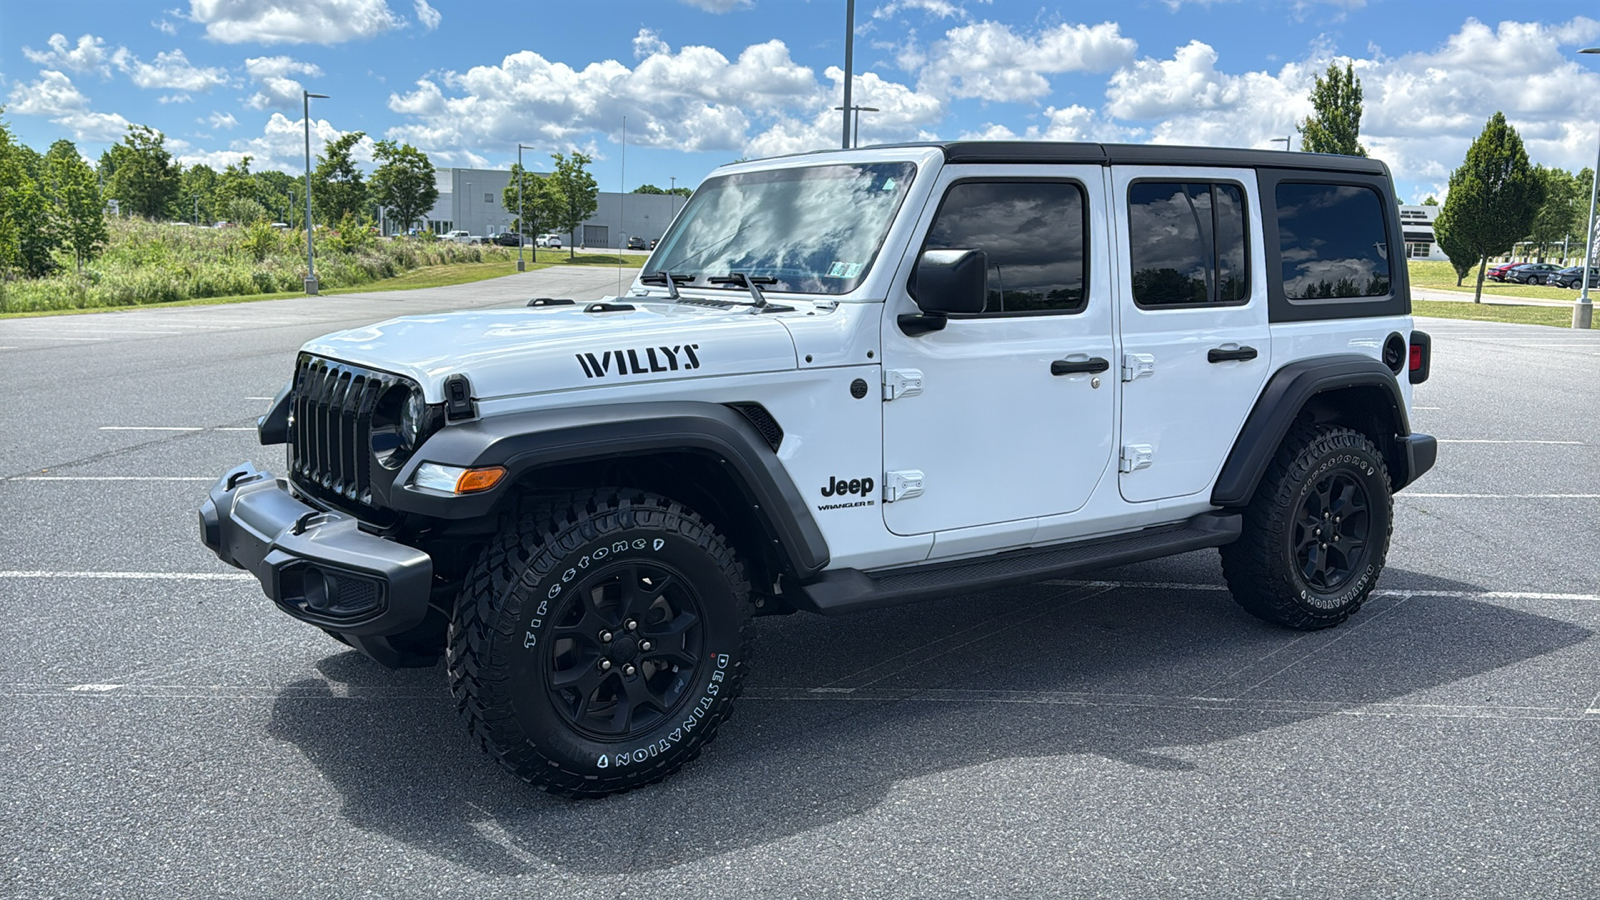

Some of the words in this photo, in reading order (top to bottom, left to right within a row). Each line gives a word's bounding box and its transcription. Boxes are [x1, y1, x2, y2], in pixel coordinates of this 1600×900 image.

[575, 344, 700, 378] WILLYS
[817, 501, 867, 511] WRANGLER
[820, 476, 875, 498] Jeep
[523, 538, 647, 649] Firestone
[1307, 563, 1375, 610] DESTINATION
[615, 653, 730, 768] DESTINATION
